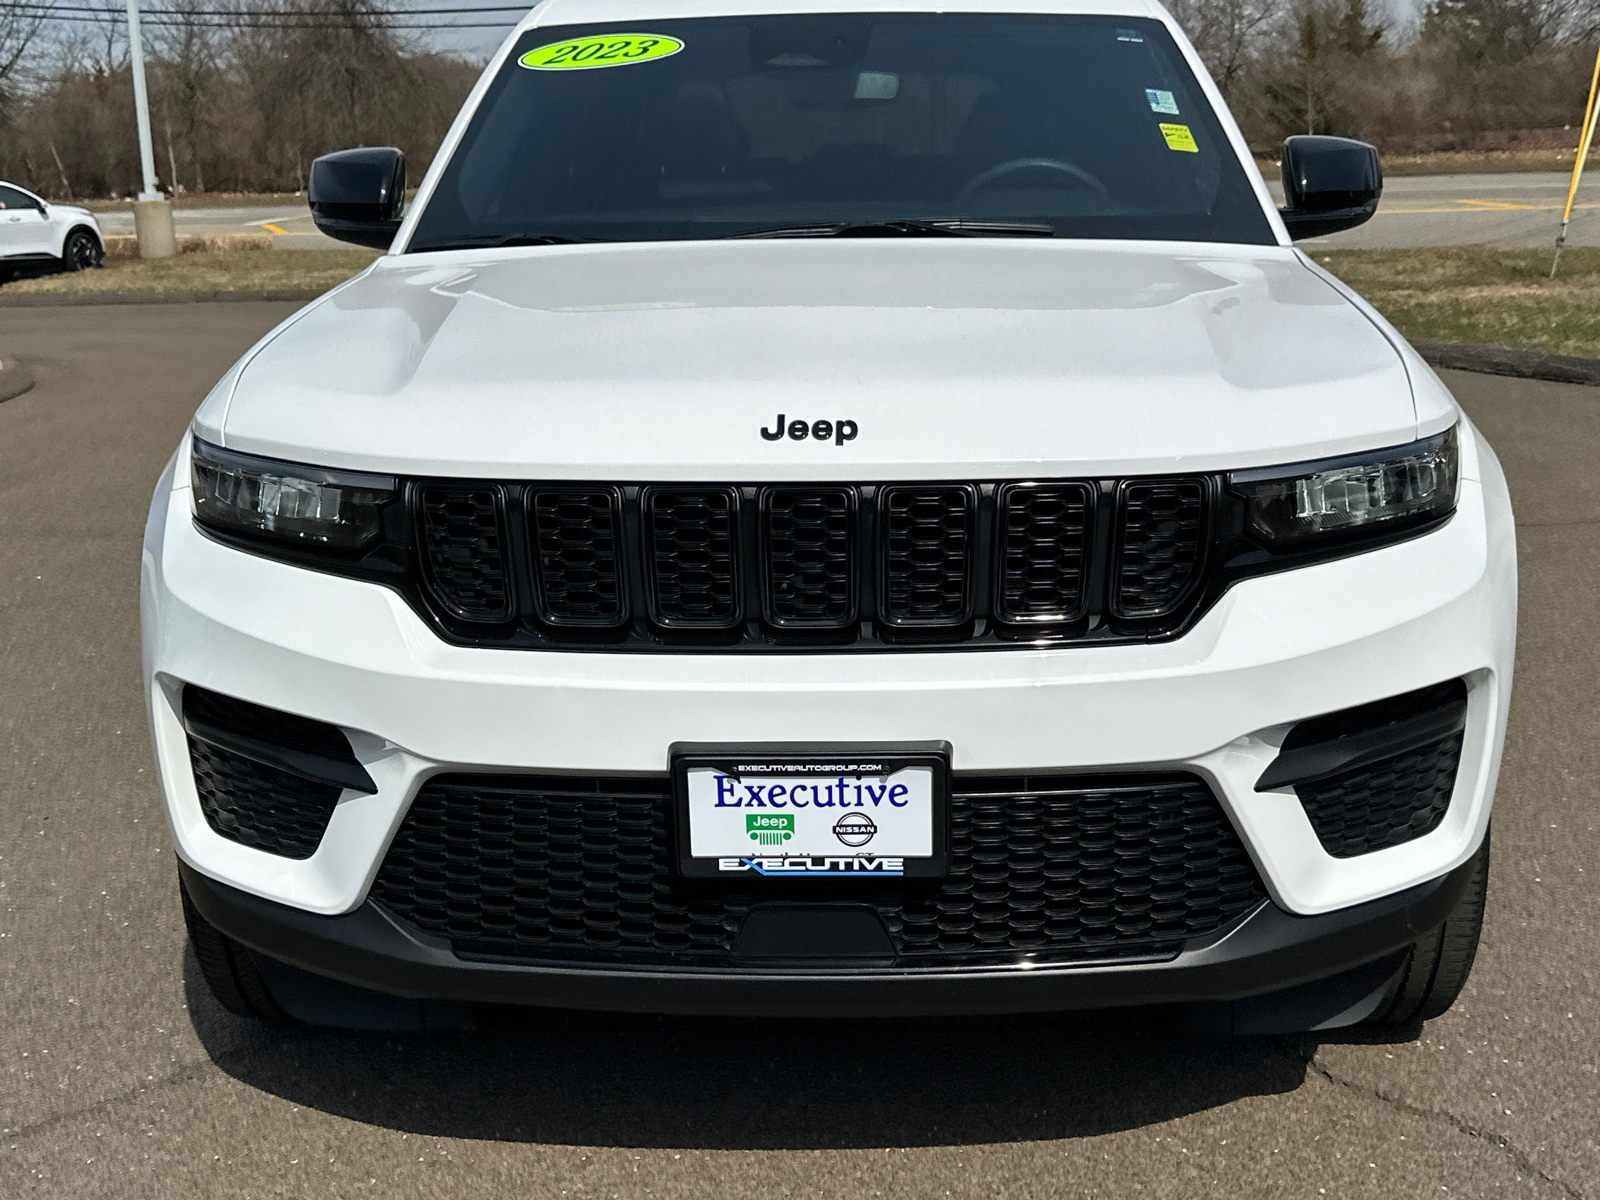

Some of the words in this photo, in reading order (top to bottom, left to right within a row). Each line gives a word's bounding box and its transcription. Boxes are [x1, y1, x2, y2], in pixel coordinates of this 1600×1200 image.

[541, 39, 660, 65] 2023
[760, 413, 859, 446] Jeep
[737, 764, 882, 772] EXECUTIVEAUTOGROUP.COM
[713, 774, 909, 808] Executive
[752, 815, 788, 829] Jeep
[835, 825, 875, 833] NISSAN
[718, 857, 904, 871] EXECUTIVE
